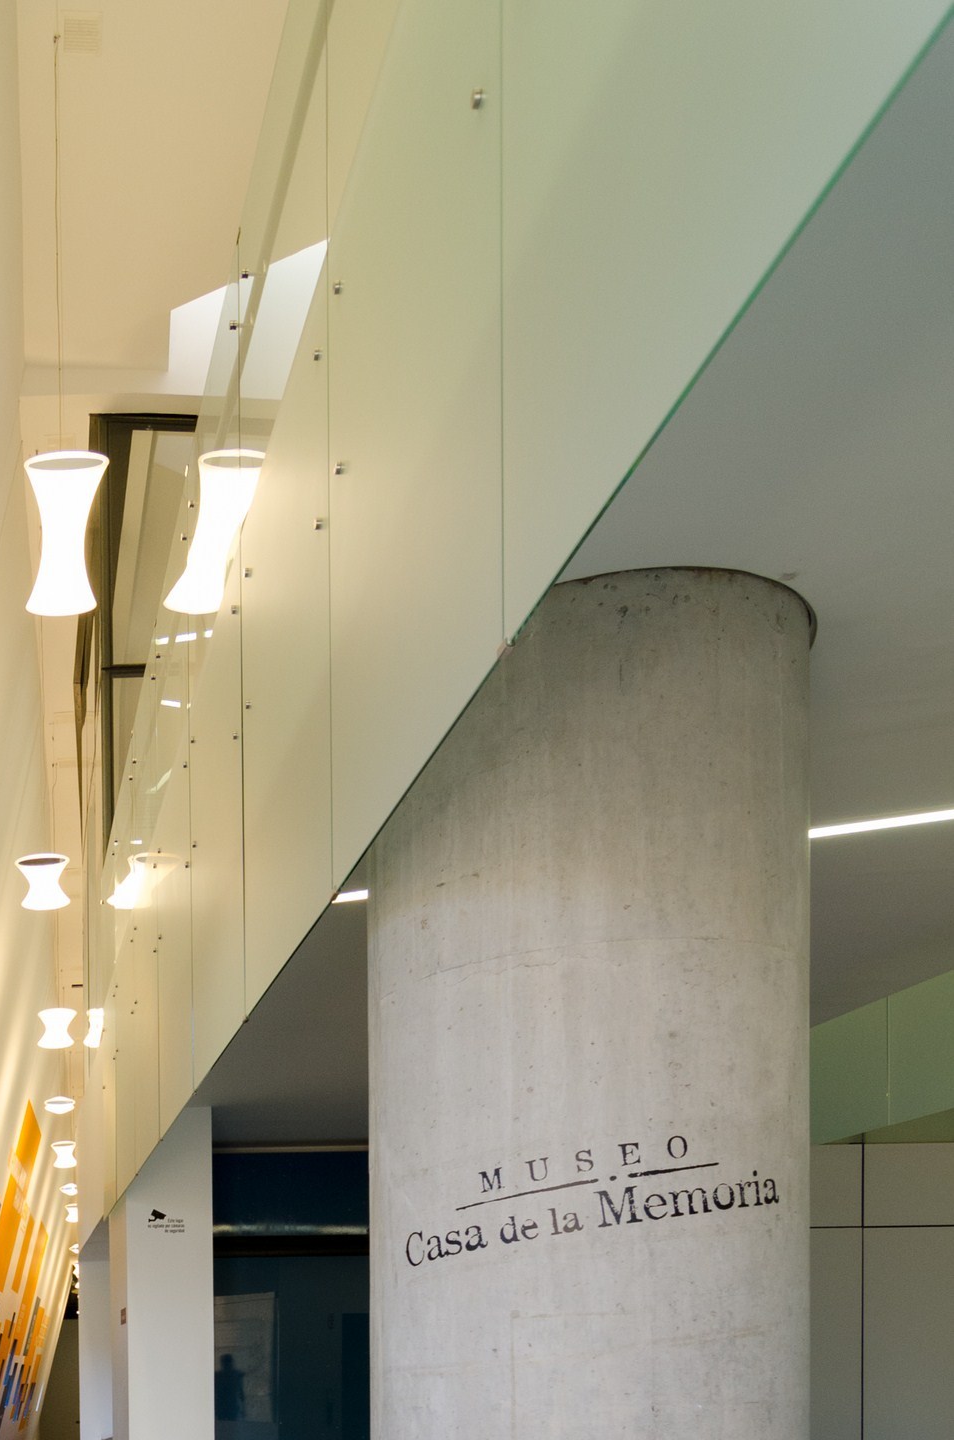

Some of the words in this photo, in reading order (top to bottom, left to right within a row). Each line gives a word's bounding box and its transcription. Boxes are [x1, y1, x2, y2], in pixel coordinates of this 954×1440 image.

[478, 1135, 689, 1194] MUSEO
[405, 1224, 488, 1267] Casa
[500, 1215, 540, 1243] de
[548, 1208, 584, 1236] la
[594, 1170, 780, 1228] Memoria
